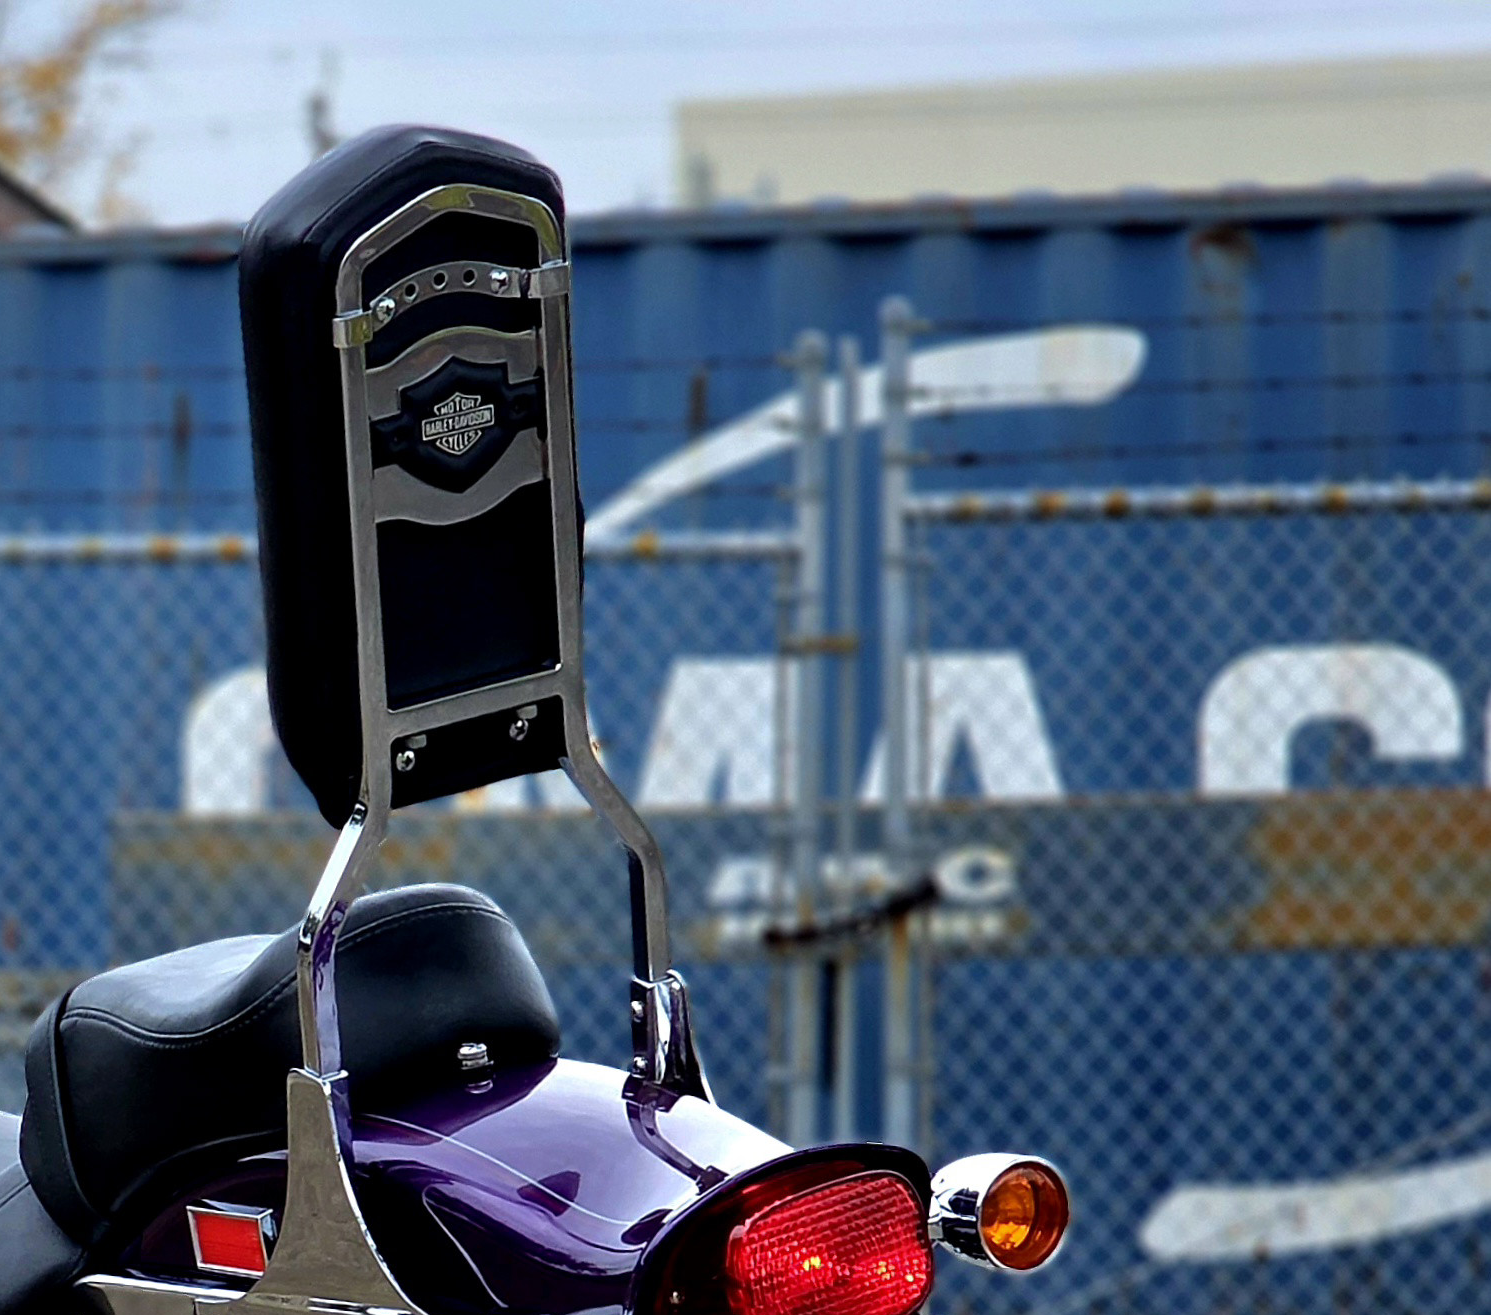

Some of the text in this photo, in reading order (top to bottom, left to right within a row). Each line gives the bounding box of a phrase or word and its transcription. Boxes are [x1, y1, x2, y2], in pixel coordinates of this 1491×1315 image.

[440, 396, 475, 415] MOTOR
[425, 409, 491, 436] HARLEY-DAVIDSON
[442, 430, 476, 451] CYCLES
